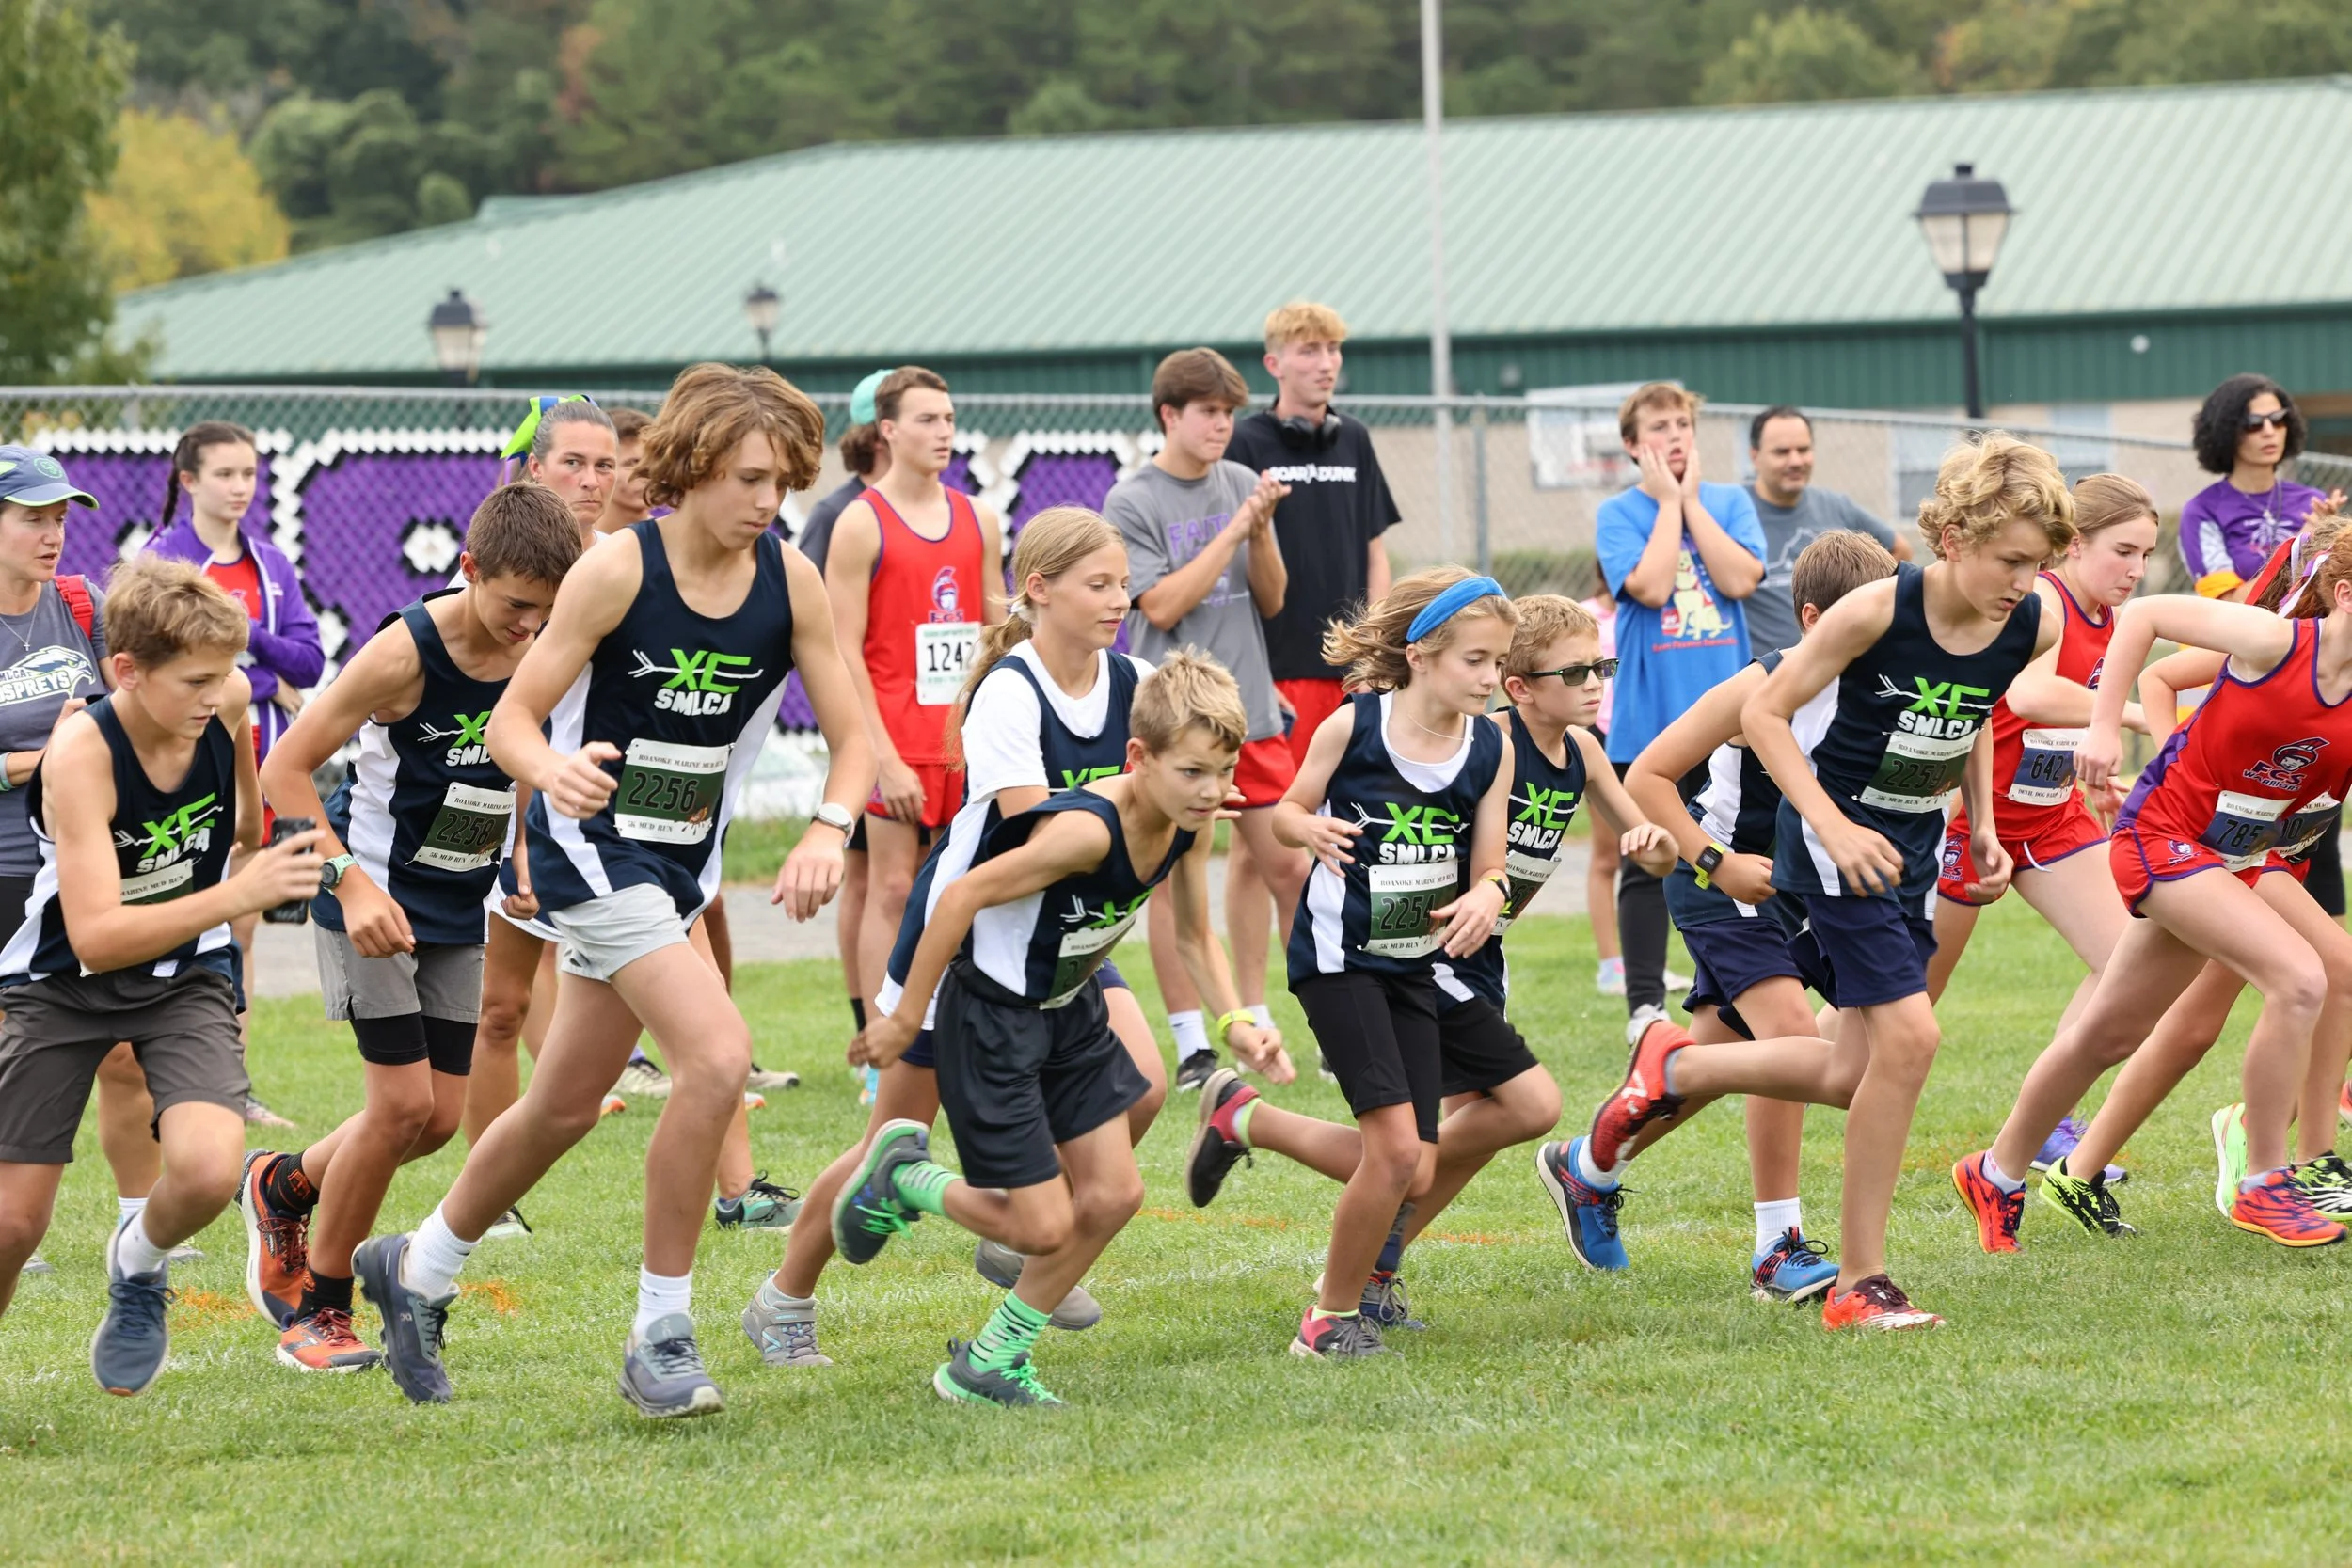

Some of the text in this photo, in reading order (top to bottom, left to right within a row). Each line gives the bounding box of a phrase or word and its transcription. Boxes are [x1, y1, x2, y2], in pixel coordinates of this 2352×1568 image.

[1167, 513, 1231, 559] FAIT
[661, 648, 751, 694] XC
[654, 688, 733, 716] SMLCA
[1905, 676, 1990, 721] XC
[1897, 710, 1974, 739] SMLCA
[638, 754, 672, 765] ROANOKE
[1883, 759, 1947, 790] 2259
[2030, 753, 2065, 782] 642
[2251, 760, 2307, 785] FCS
[626, 771, 700, 813] 2256
[2243, 769, 2302, 791] WARRIORS
[454, 798, 481, 807] ROANOKE
[483, 801, 501, 810] MARINE
[1515, 782, 1574, 829] XC
[140, 792, 215, 859] XC
[435, 813, 497, 847] 2258
[657, 824, 673, 832] RUN
[1381, 801, 1459, 845] XC
[2216, 818, 2265, 848] 785
[151, 879, 167, 891] MUD
[168, 875, 184, 886] RUN
[1379, 894, 1437, 931] 2254
